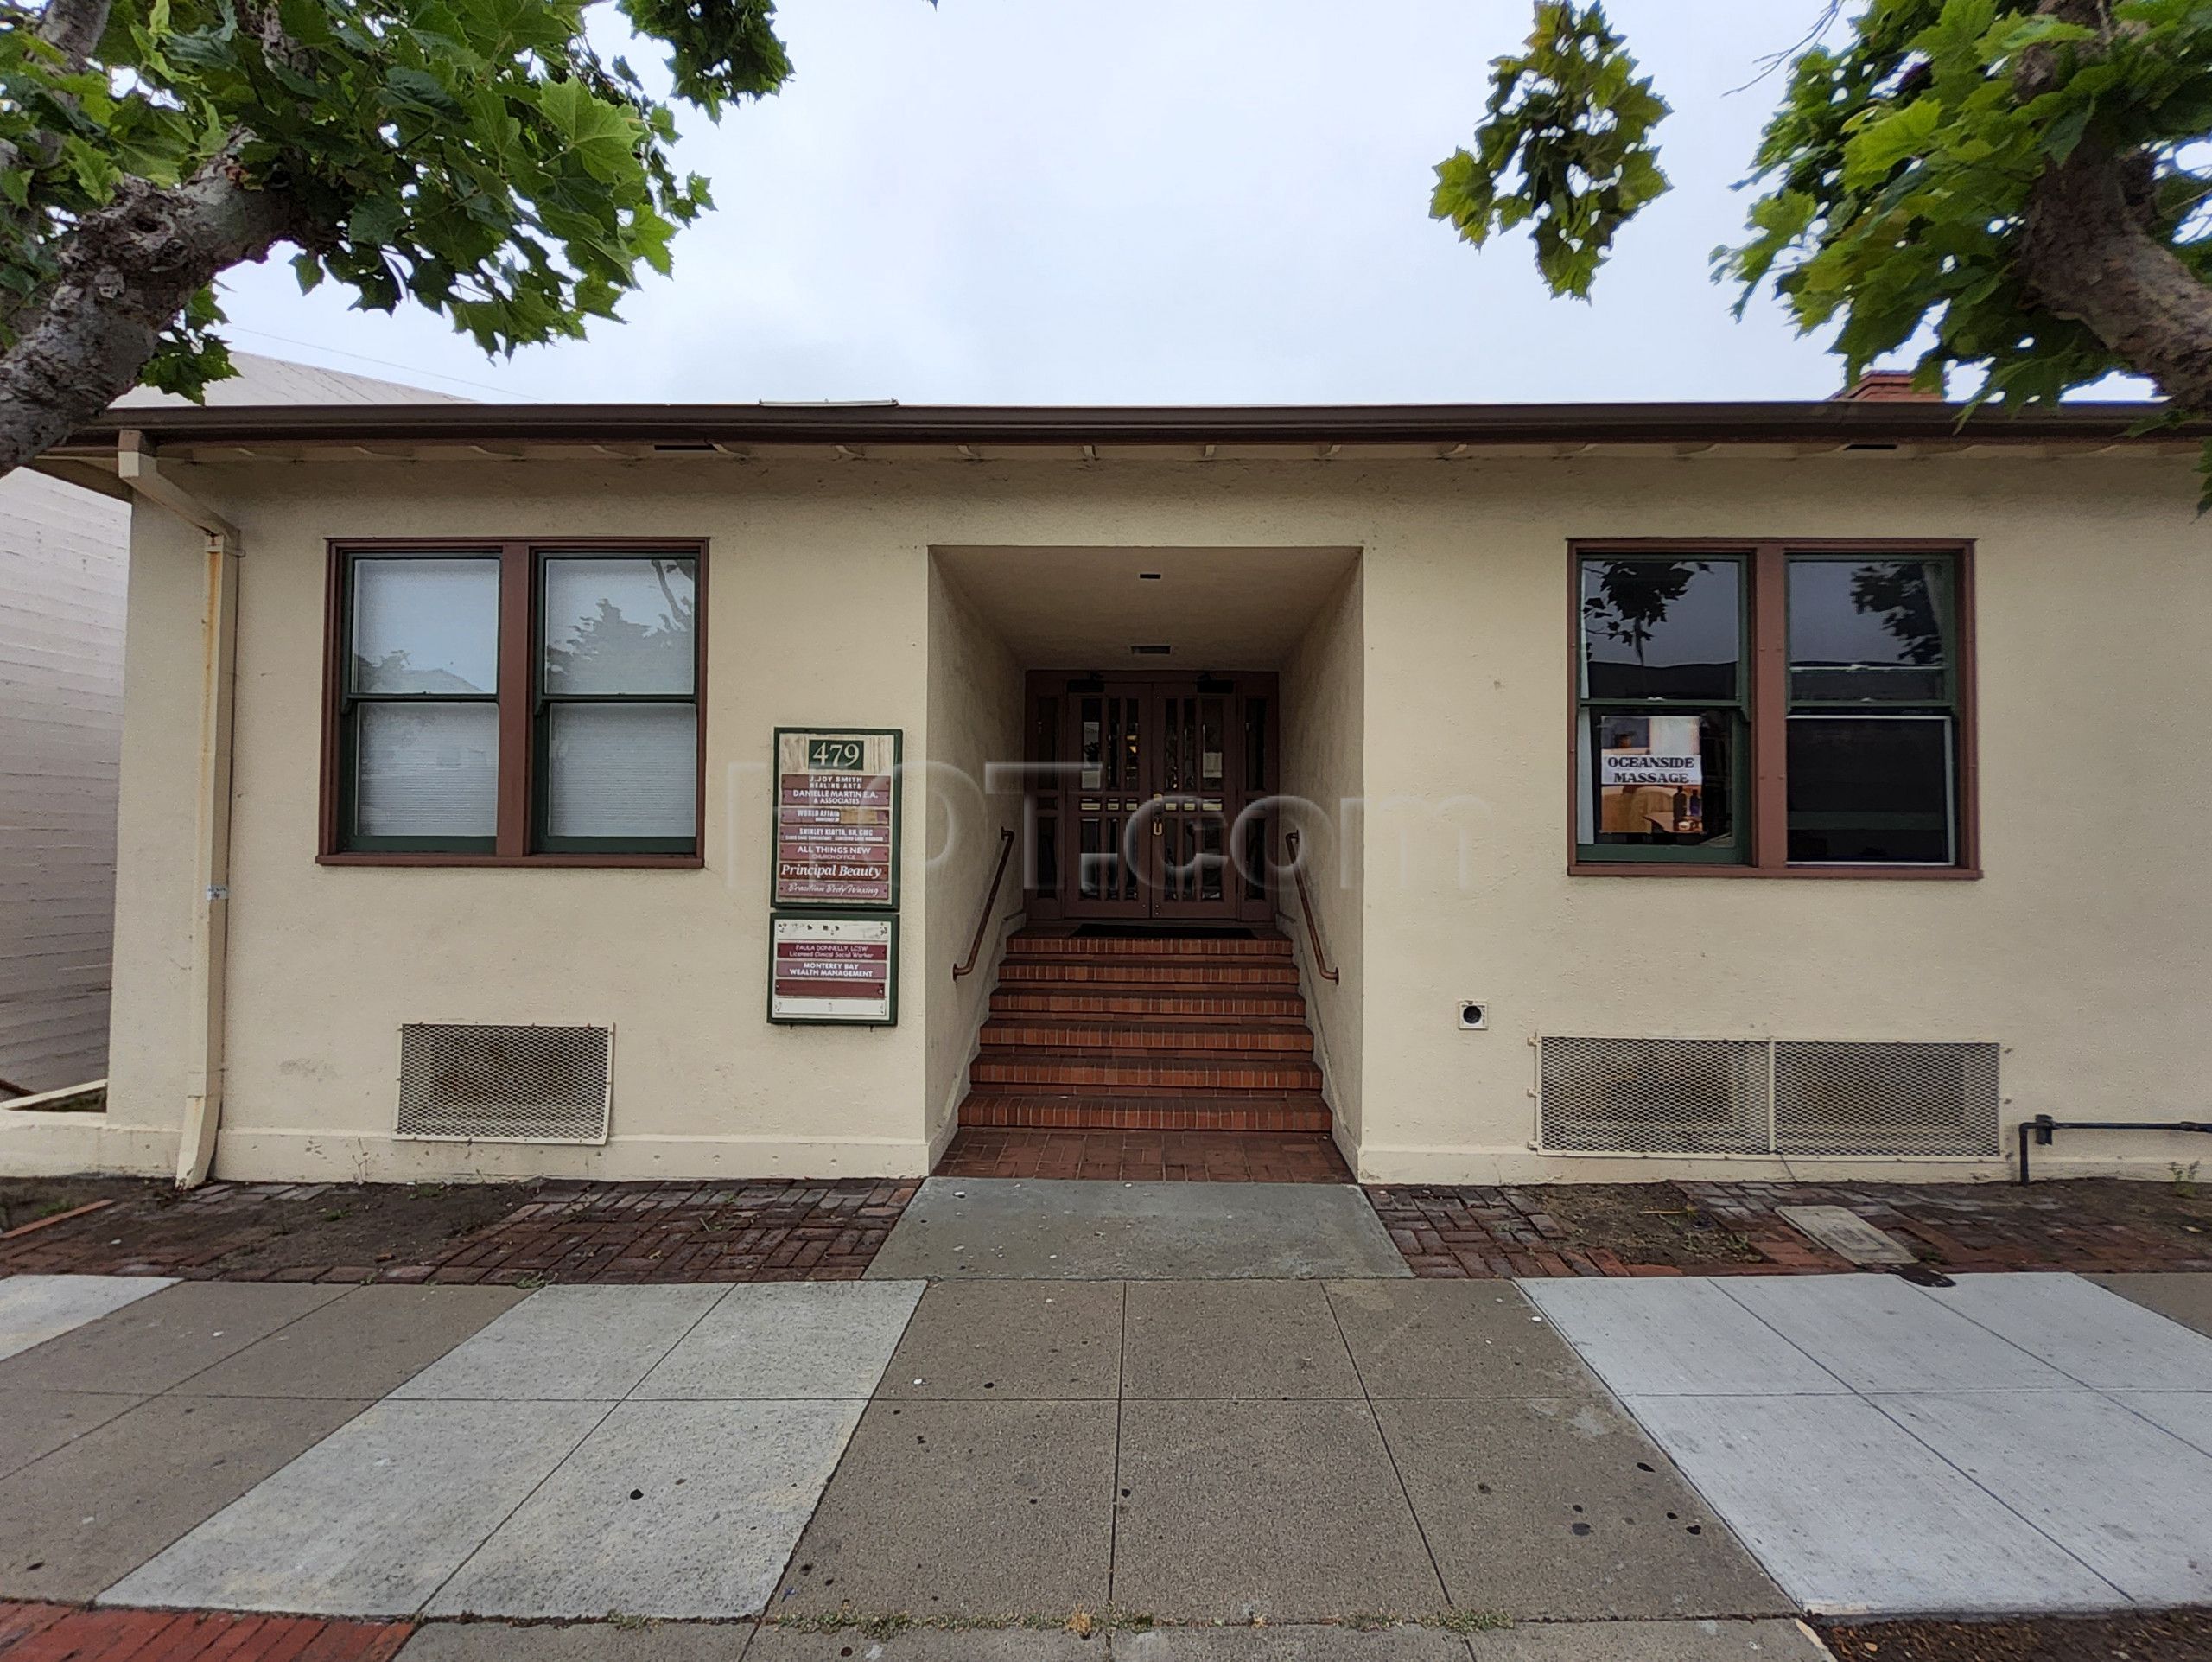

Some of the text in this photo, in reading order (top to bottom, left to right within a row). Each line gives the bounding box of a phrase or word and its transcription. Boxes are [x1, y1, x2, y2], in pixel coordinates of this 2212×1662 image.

[813, 742, 860, 767] 479
[1607, 756, 1695, 769] OCEANSIDE
[1613, 772, 1690, 784] MASSAGE
[781, 864, 882, 879] Principal Beauty
[788, 882, 879, 896] Brazilian Body Waxing
